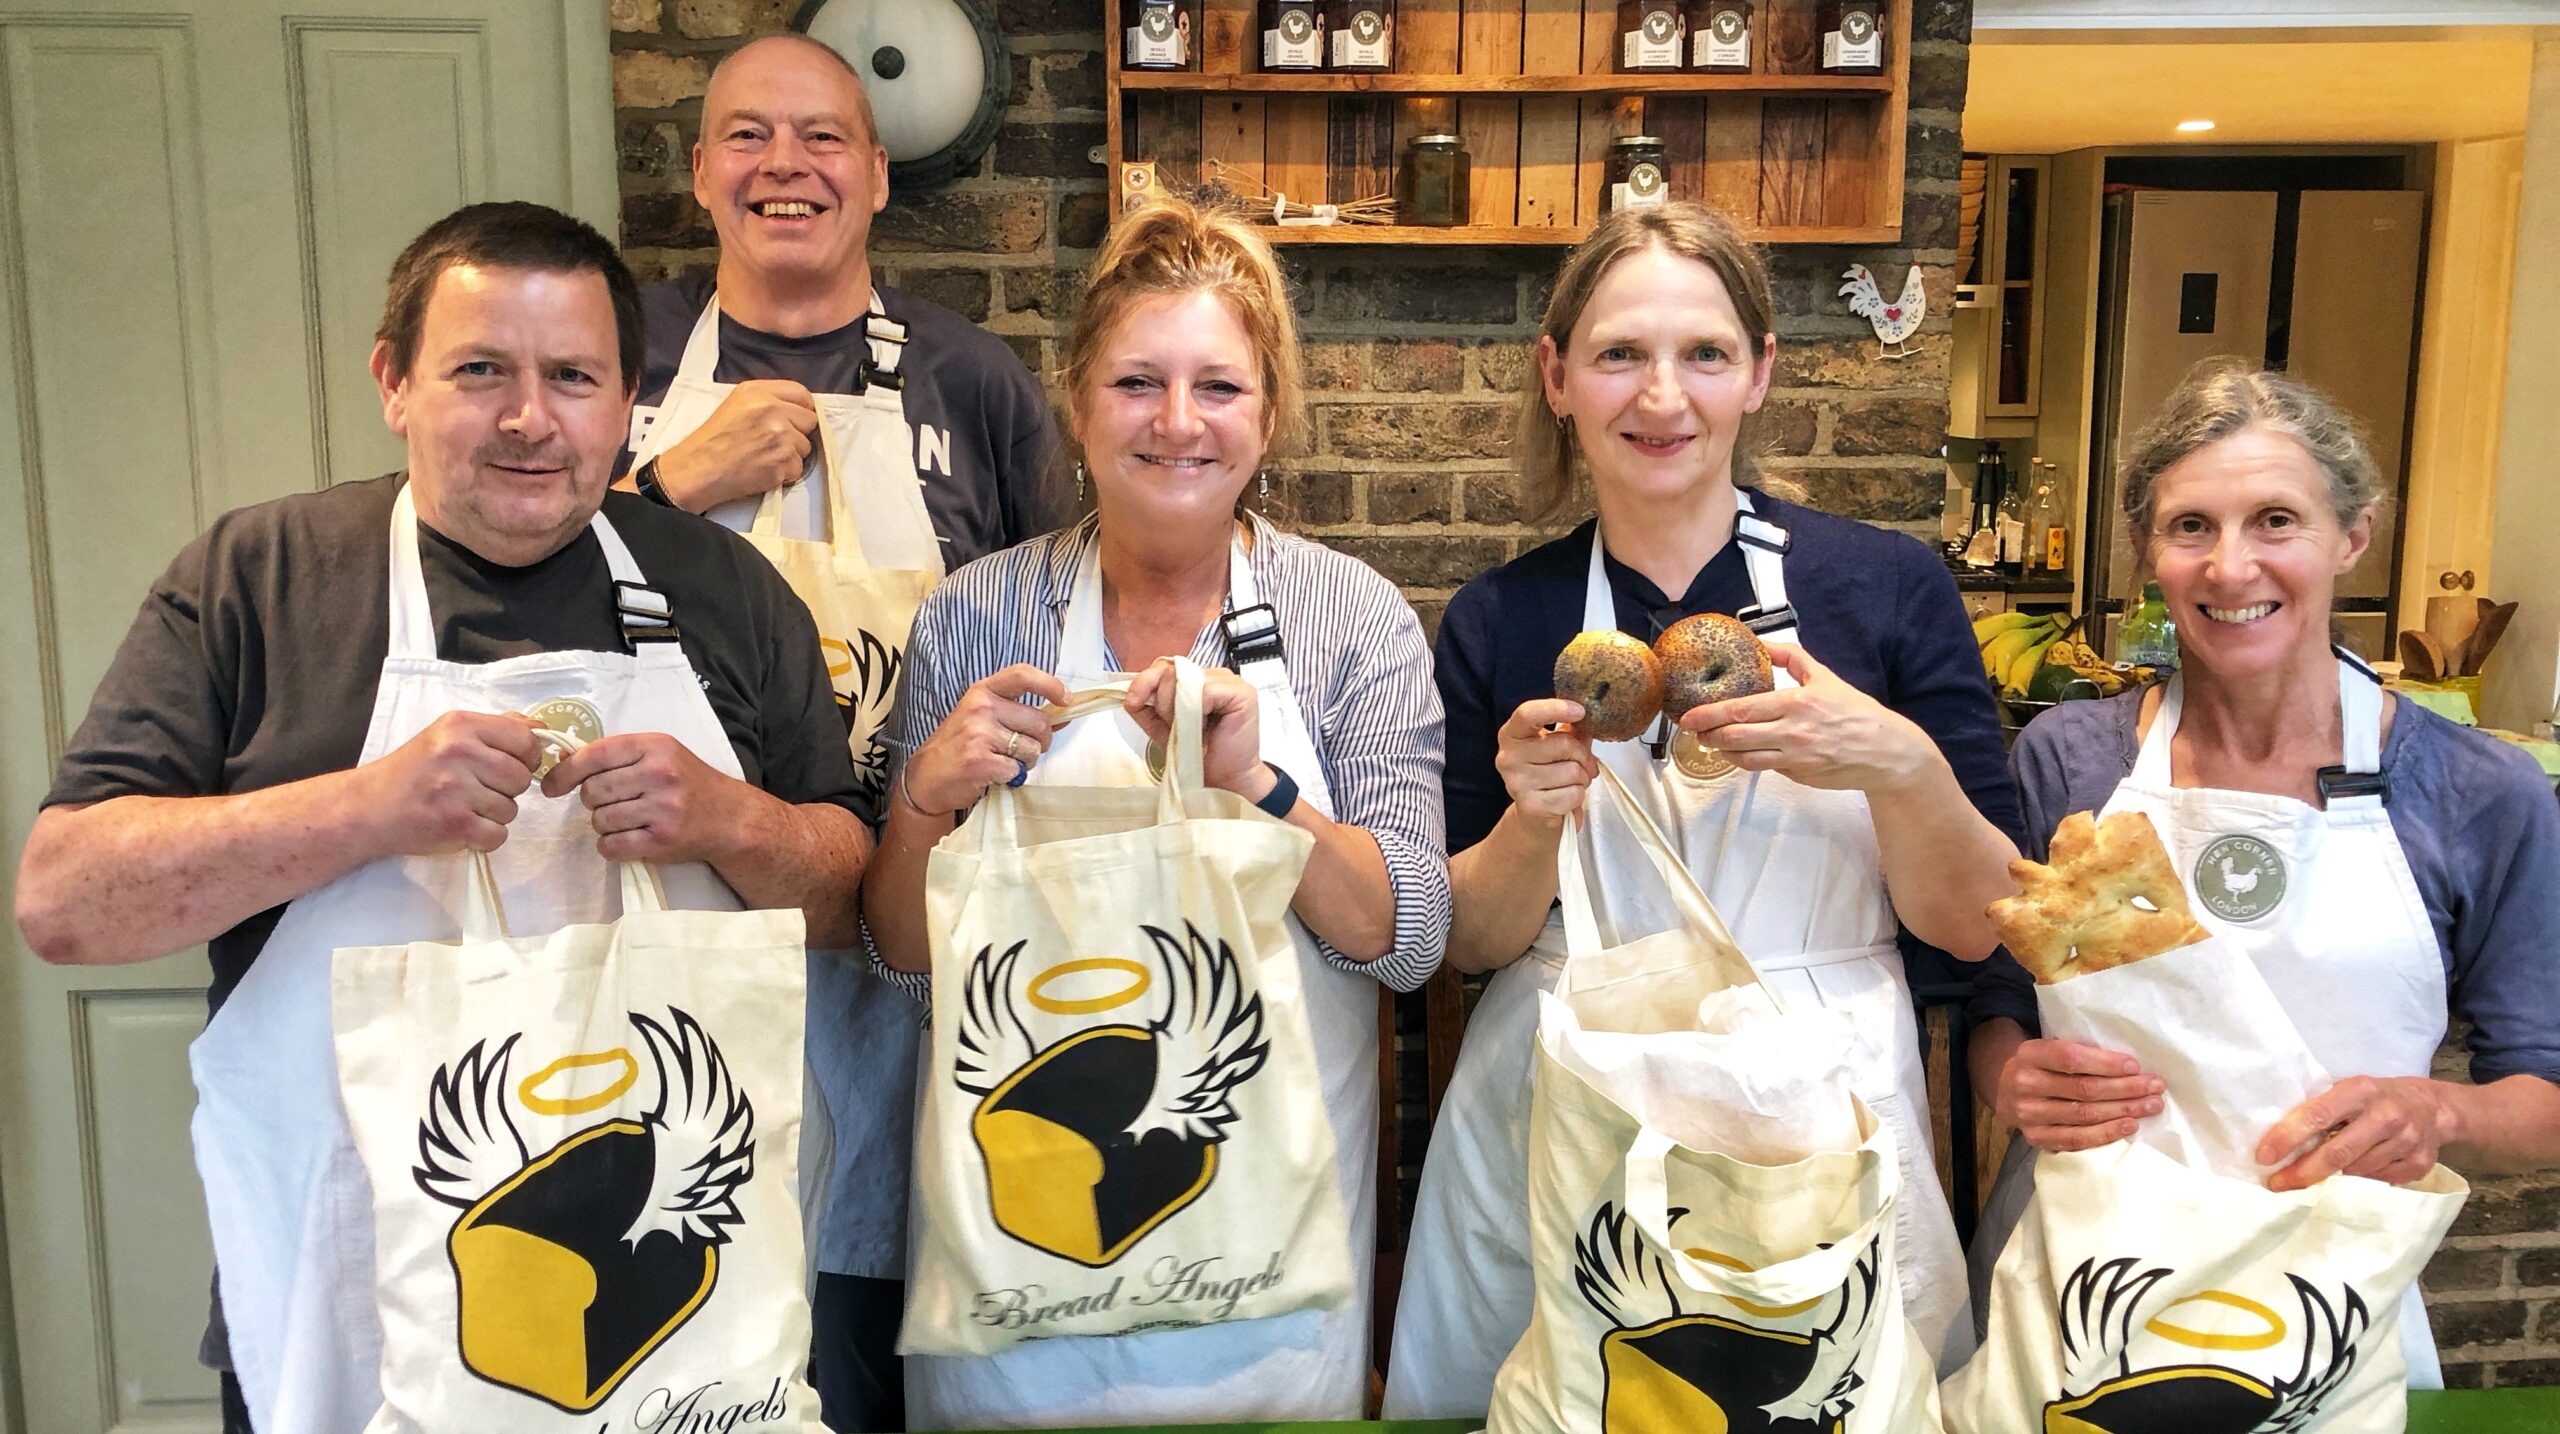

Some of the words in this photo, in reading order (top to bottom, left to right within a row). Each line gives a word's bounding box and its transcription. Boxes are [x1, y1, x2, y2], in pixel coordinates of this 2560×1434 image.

[547, 704, 593, 728] CORNER
[2207, 844, 2230, 866] HEN
[2234, 841, 2278, 876] CORNER
[2211, 895, 2258, 915] LONDON
[969, 1276, 1125, 1330] Bread
[634, 1376, 787, 1434] Angels
